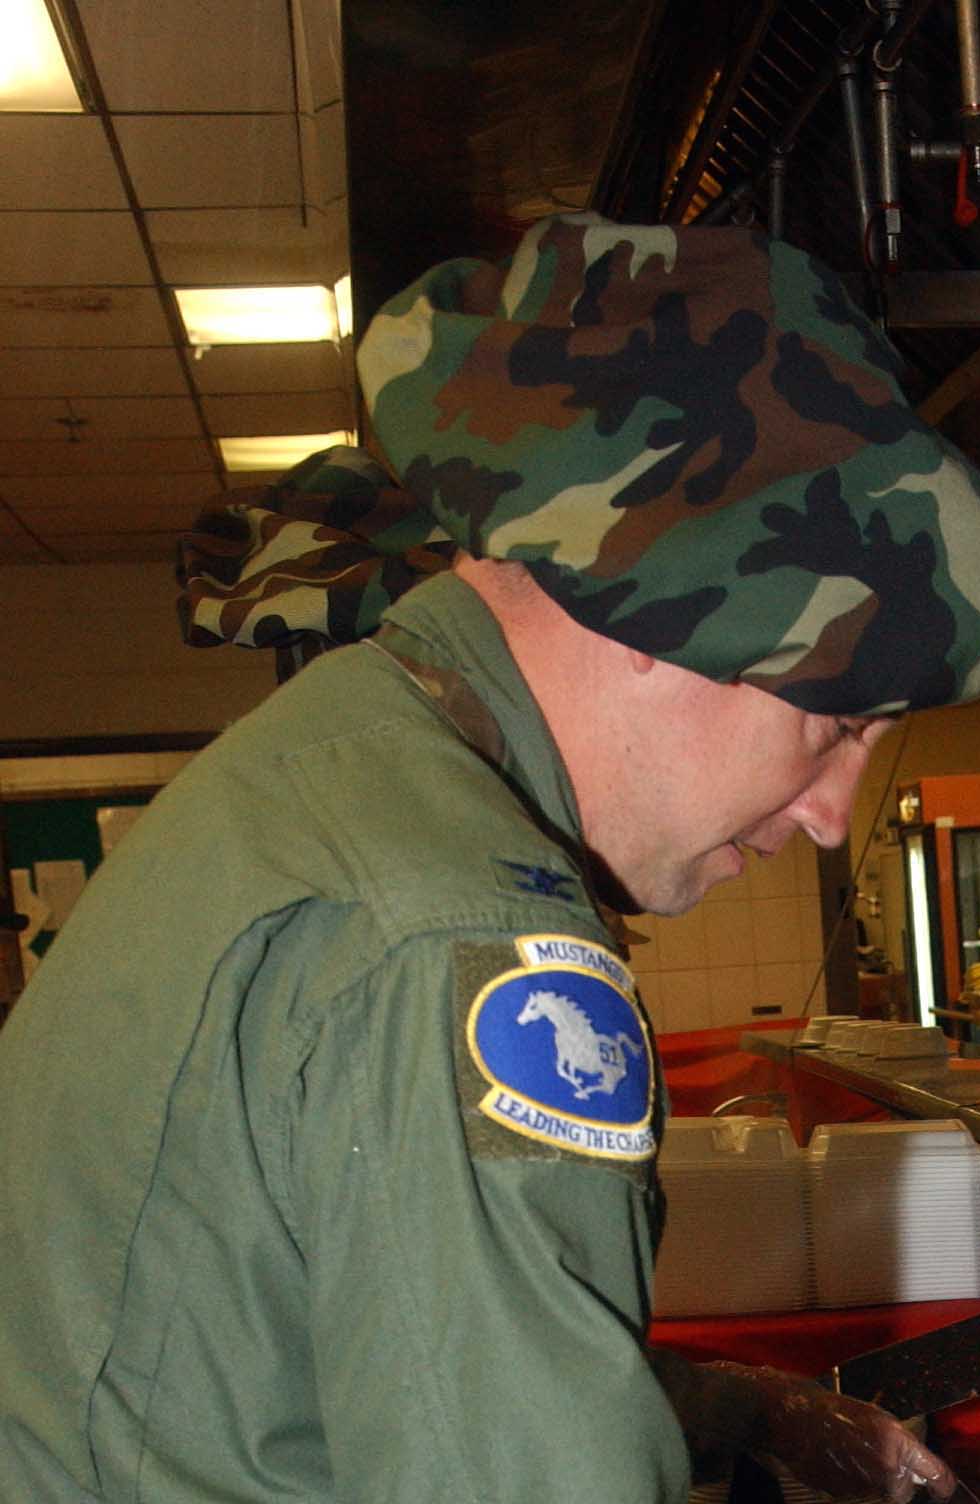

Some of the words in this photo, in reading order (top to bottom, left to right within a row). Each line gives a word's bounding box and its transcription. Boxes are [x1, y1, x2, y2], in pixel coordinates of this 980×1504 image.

[597, 1042, 619, 1066] 51
[493, 1092, 582, 1142] LEADING
[584, 1127, 615, 1151] THE
